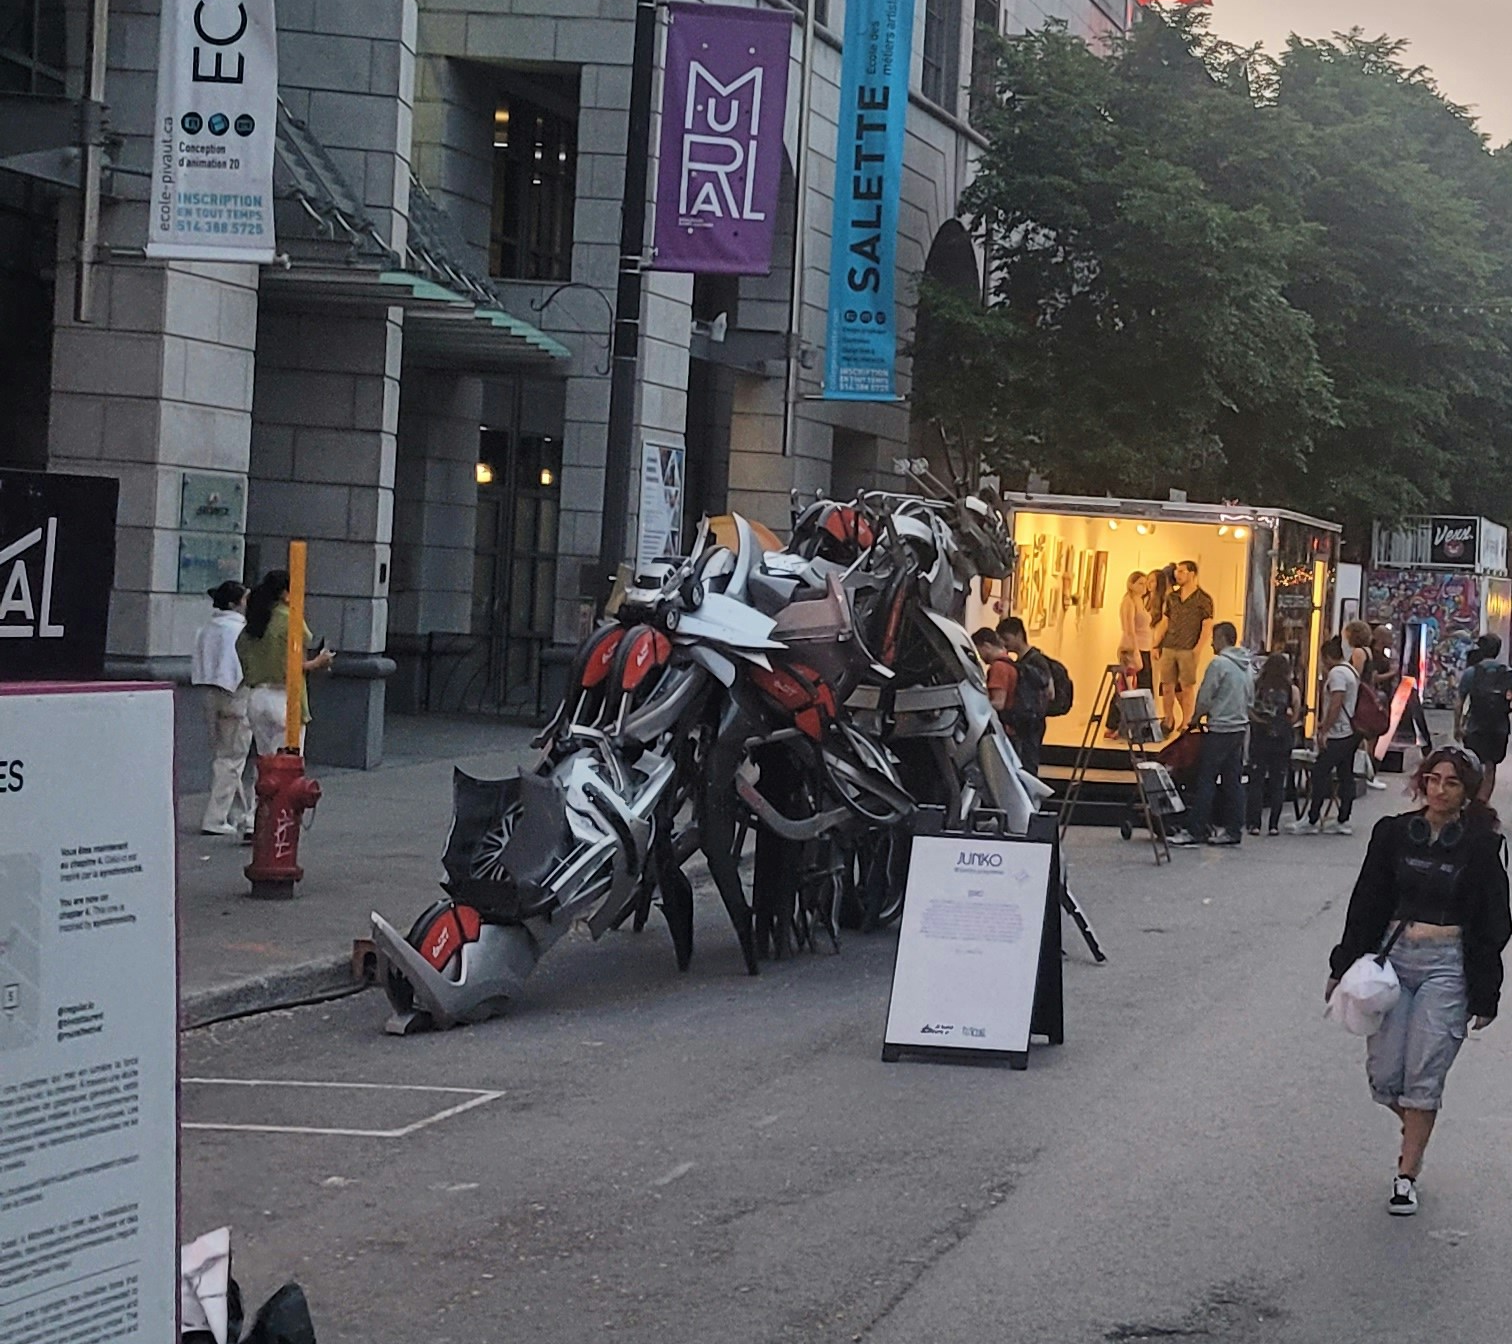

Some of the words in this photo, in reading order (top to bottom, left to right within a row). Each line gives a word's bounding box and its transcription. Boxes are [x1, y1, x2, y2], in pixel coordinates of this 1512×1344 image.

[679, 60, 765, 221] MURAL
[159, 117, 175, 232] ecole-pivaut.ca
[178, 192, 262, 207] INSCRIPTION
[847, 85, 890, 294] SALETTE
[195, 208, 225, 219] TOUT
[227, 209, 263, 221] TEMPS
[957, 851, 1003, 867] JUNKO
